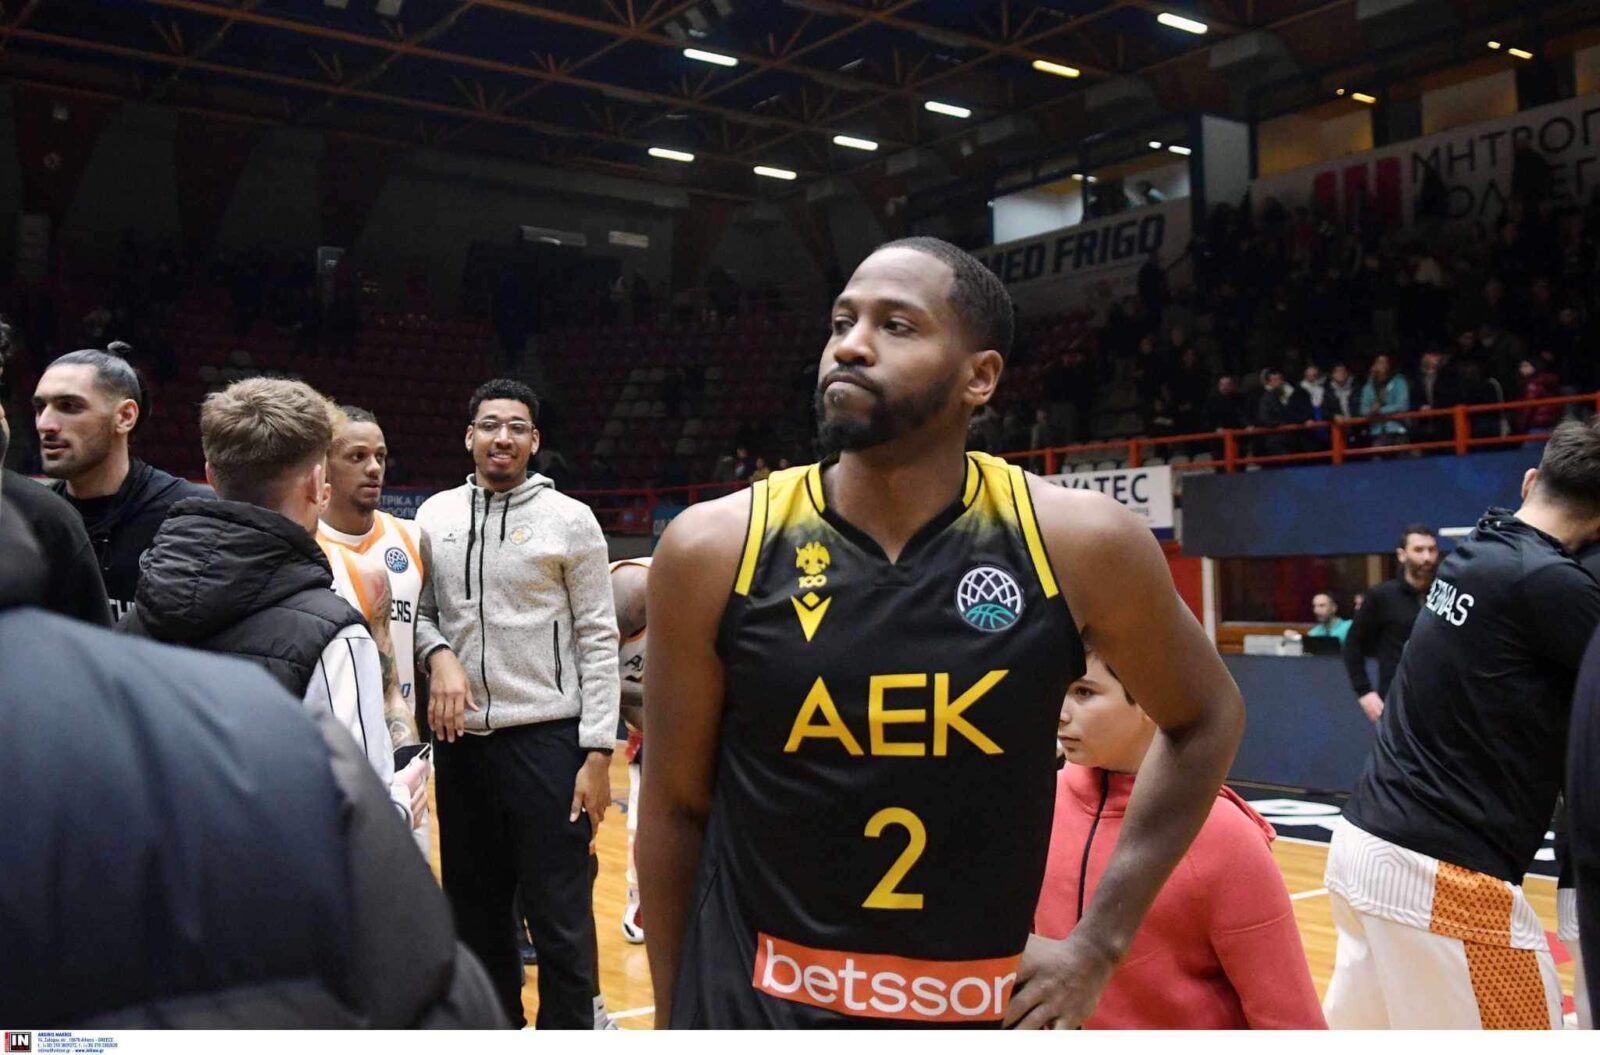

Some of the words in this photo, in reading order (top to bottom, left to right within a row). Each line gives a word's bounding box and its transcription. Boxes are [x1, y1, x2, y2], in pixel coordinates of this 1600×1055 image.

[1053, 214, 1164, 273] FRIGO
[799, 575, 827, 588] 100
[784, 670, 1009, 756] AEK
[861, 806, 926, 909] 2
